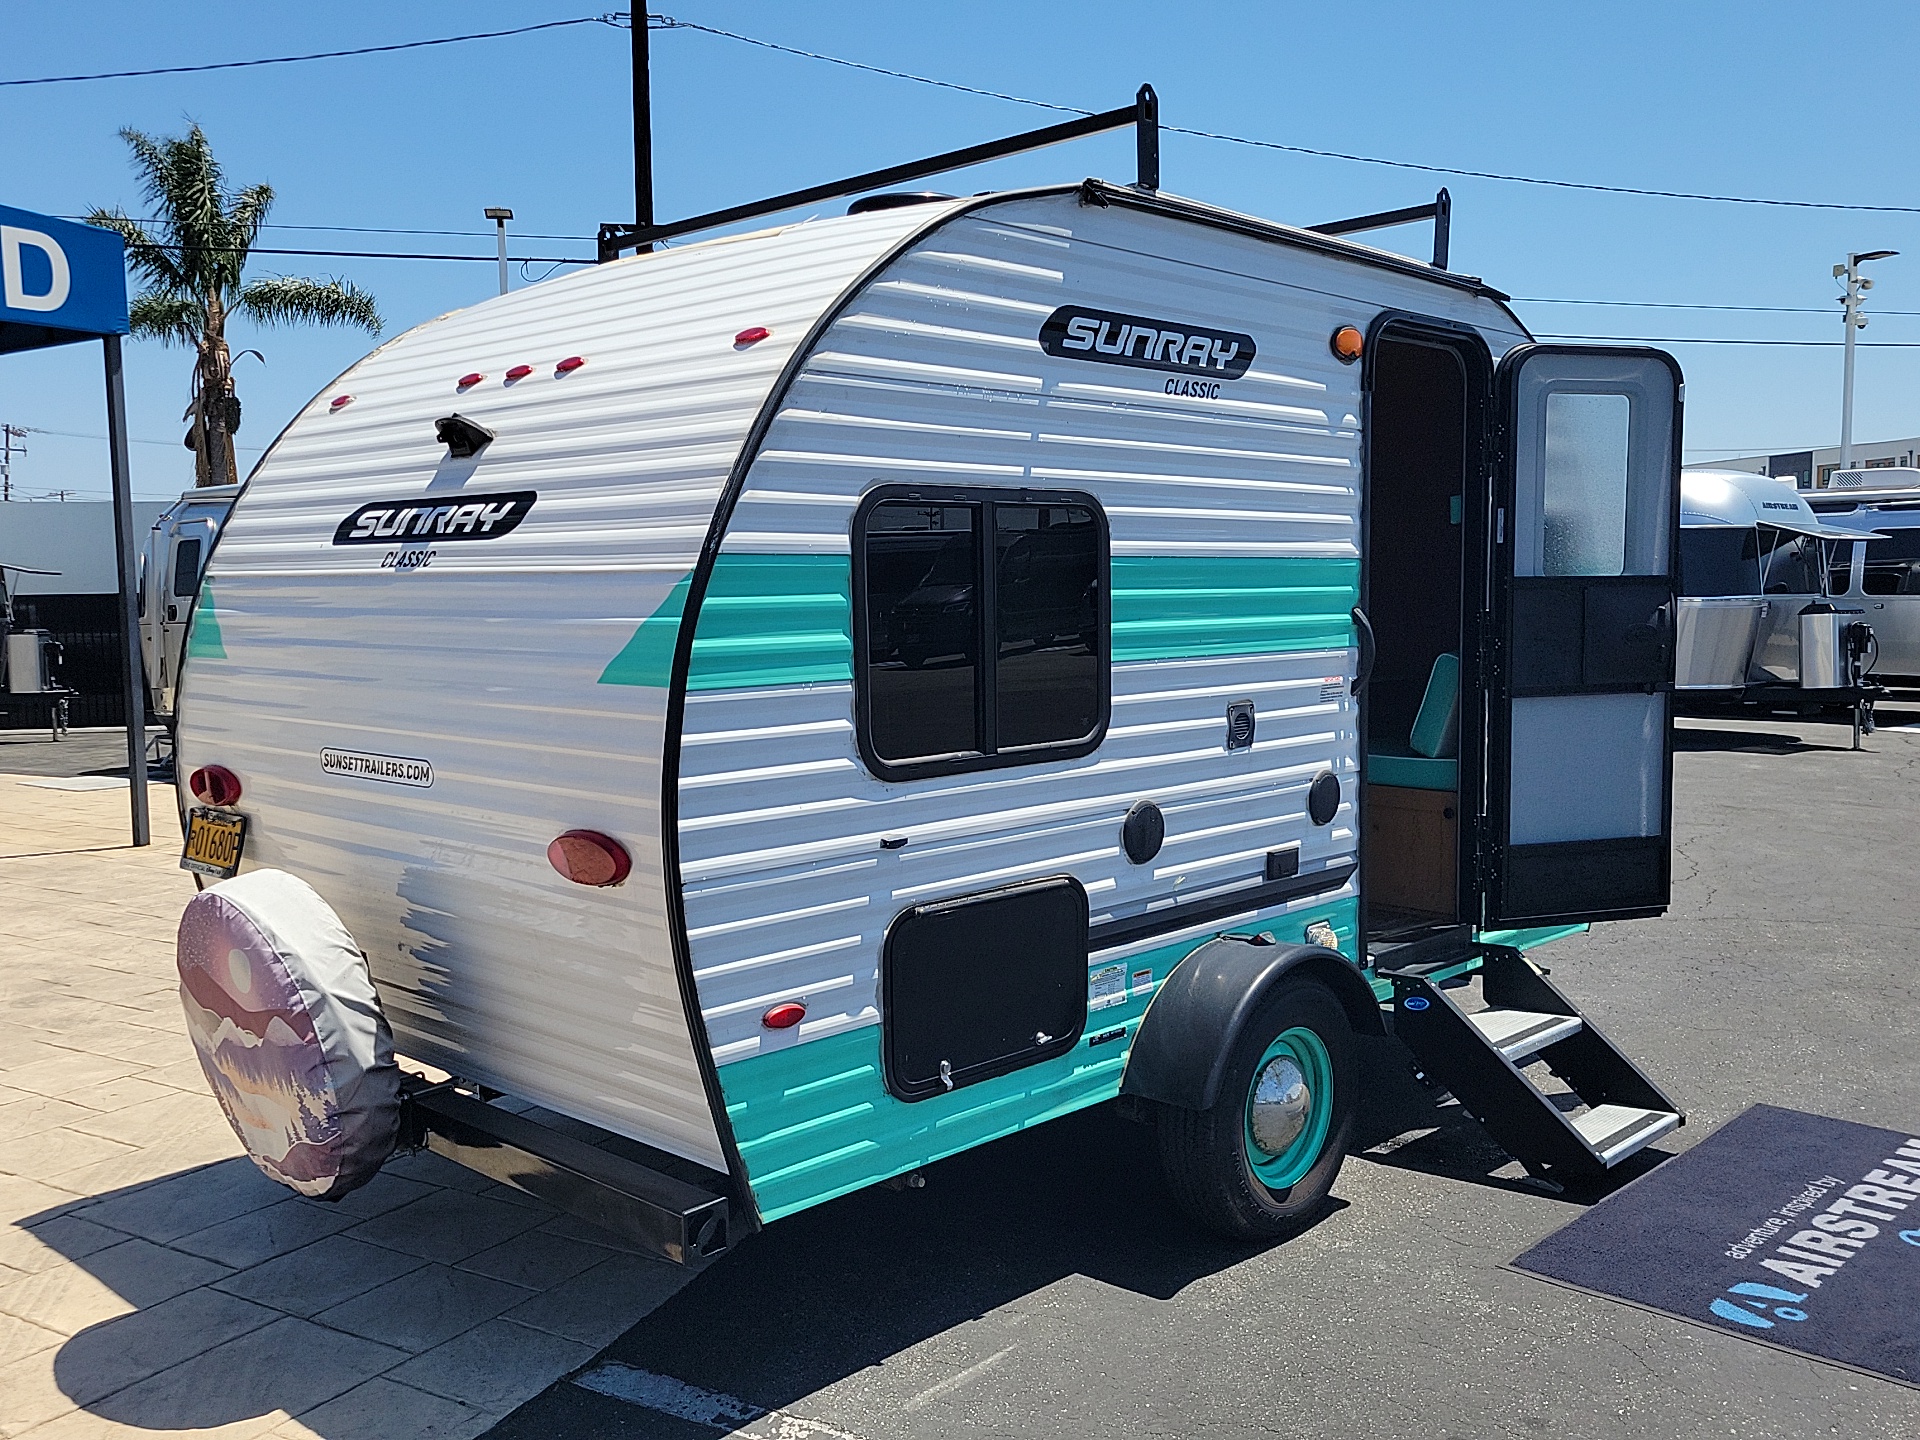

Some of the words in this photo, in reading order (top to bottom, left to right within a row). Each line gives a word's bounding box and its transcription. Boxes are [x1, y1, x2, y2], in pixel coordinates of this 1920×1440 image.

[1, 225, 71, 312] D
[1062, 316, 1239, 370] SUNRAY
[1164, 378, 1221, 400] CLASSIC
[349, 501, 517, 538] SUNRAY
[380, 550, 437, 569] CLASSIC
[323, 753, 430, 782] SUNSETTRAILERS.COM
[1724, 1216, 1796, 1259] adventure,
[1771, 1183, 1828, 1218] inspired
[1808, 1174, 1846, 1189] by
